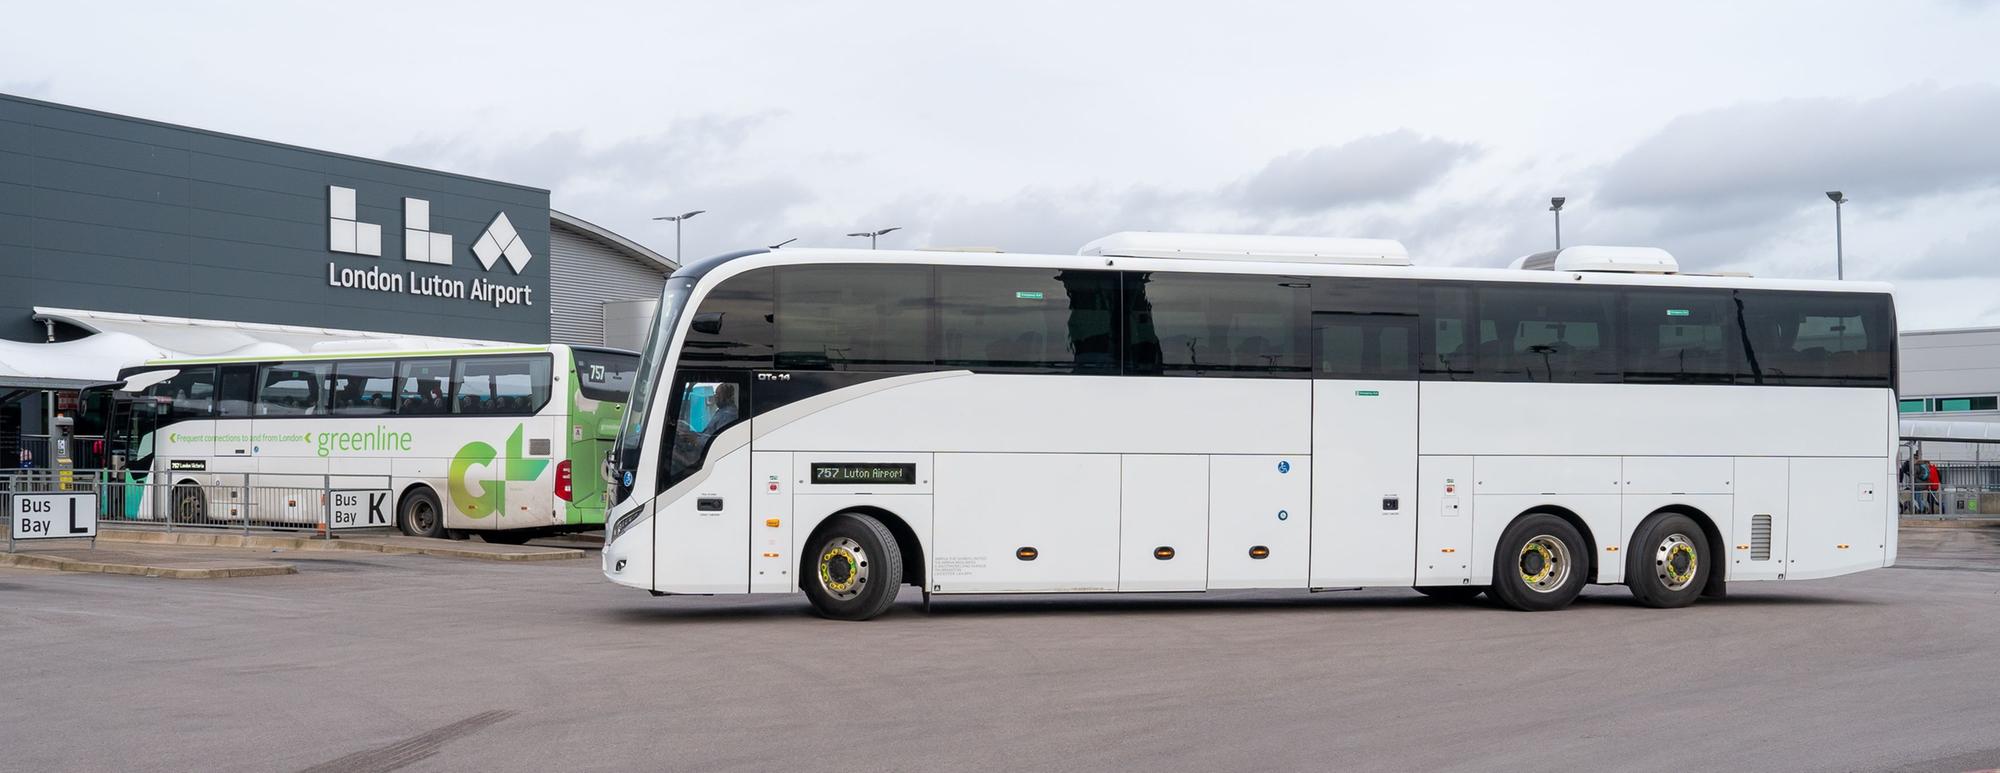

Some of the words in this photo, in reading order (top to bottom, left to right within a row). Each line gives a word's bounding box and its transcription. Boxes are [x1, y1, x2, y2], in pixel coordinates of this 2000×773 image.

[329, 262, 403, 293] London
[410, 271, 464, 299] Luton
[470, 278, 532, 308] Airport
[590, 364, 605, 380] 757
[176, 434, 203, 443] Frequent
[317, 425, 412, 457] greenline
[816, 467, 840, 479] 757
[844, 467, 870, 479] Luton
[872, 467, 903, 479] Airport
[21, 498, 51, 513] Bus
[335, 493, 357, 507] Bus
[368, 492, 387, 524] K
[69, 497, 89, 534] L
[335, 510, 357, 526] Bay
[21, 518, 51, 536] Bay
